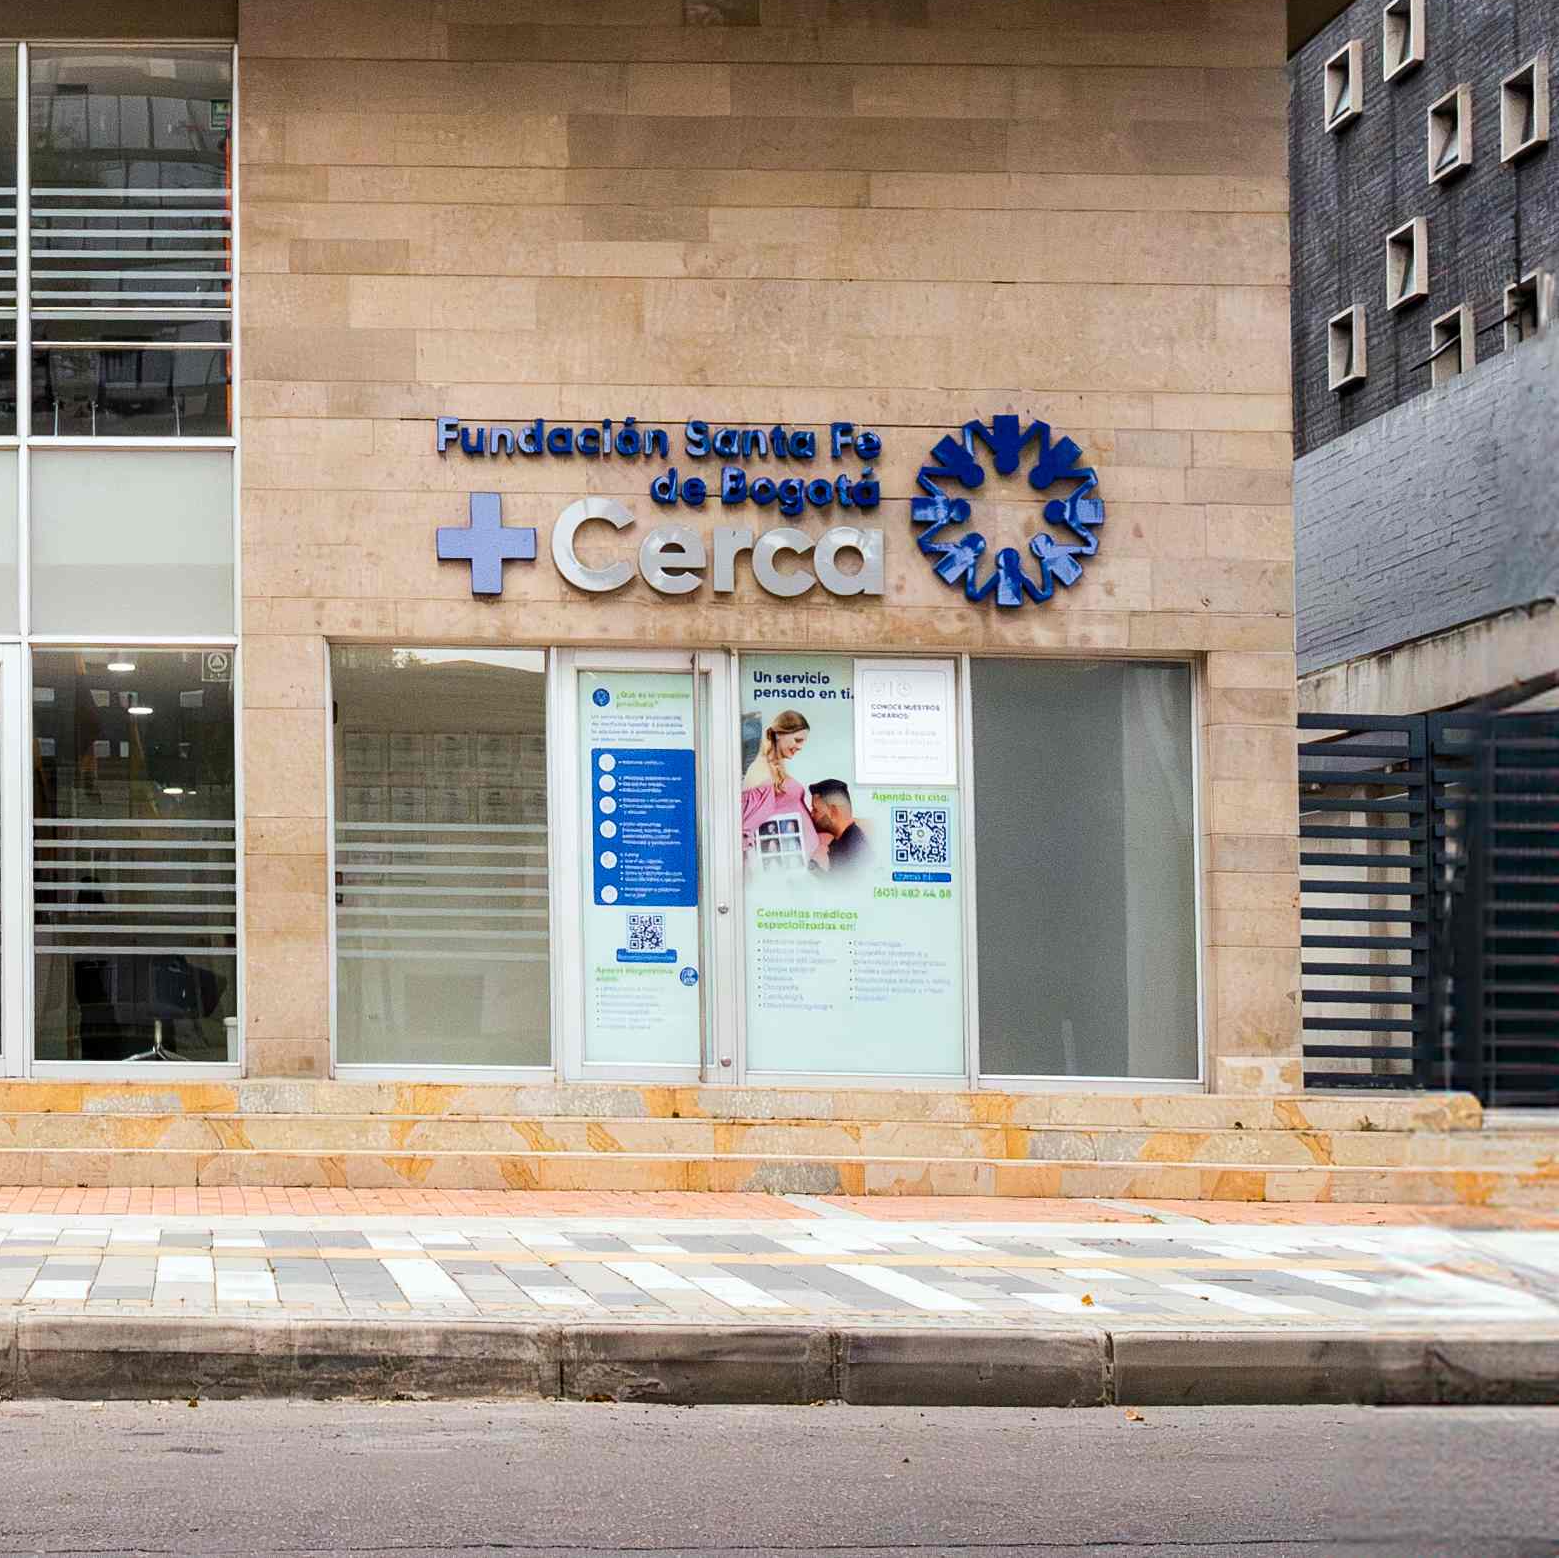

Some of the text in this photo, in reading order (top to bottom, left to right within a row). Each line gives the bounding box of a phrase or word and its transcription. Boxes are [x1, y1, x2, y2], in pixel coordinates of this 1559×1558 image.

[436, 416, 881, 460] Fundación Santa Fe
[650, 467, 880, 516] de Bogotá
[753, 671, 830, 684] Un servicio
[753, 687, 854, 701] pensado en ti.
[756, 908, 811, 918] Consultas
